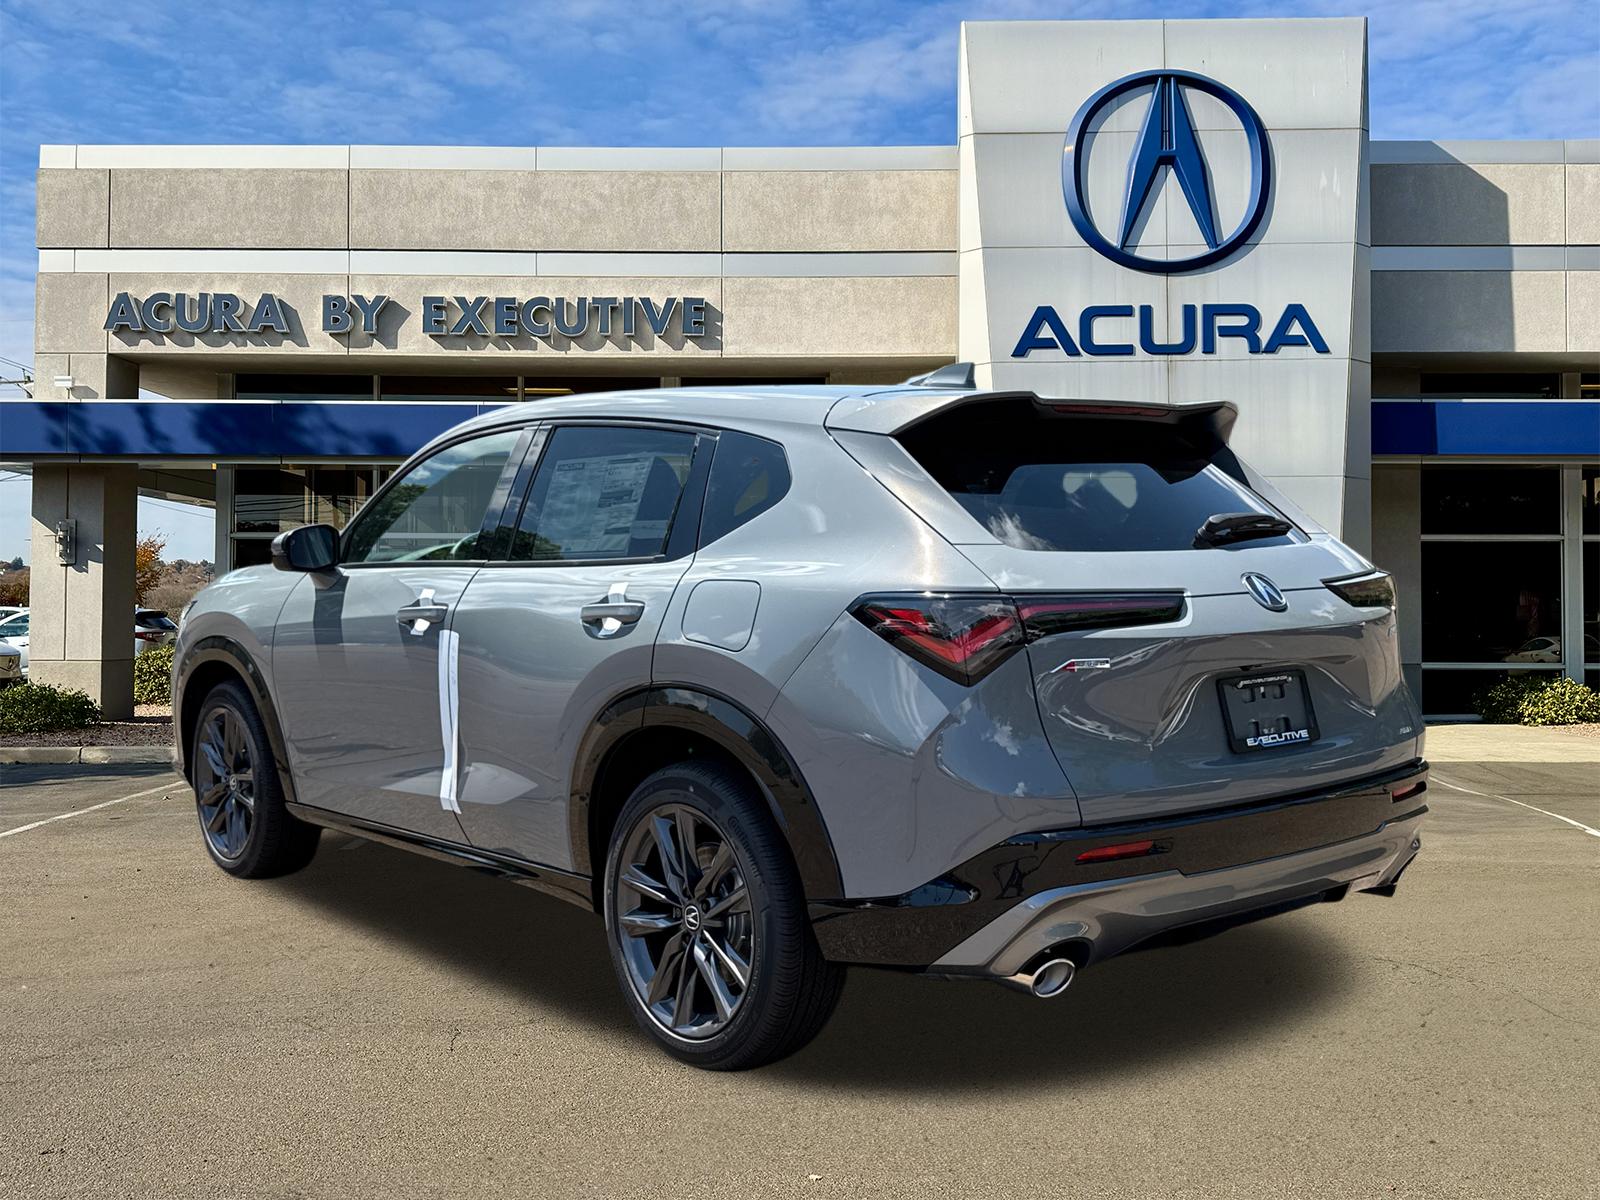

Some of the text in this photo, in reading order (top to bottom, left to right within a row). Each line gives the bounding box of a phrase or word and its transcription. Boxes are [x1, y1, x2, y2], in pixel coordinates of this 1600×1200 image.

[104, 292, 706, 337] ACURA BY EXECUTIVE
[1011, 303, 1331, 357] ACURA
[1246, 729, 1310, 747] EXECUTIVE
